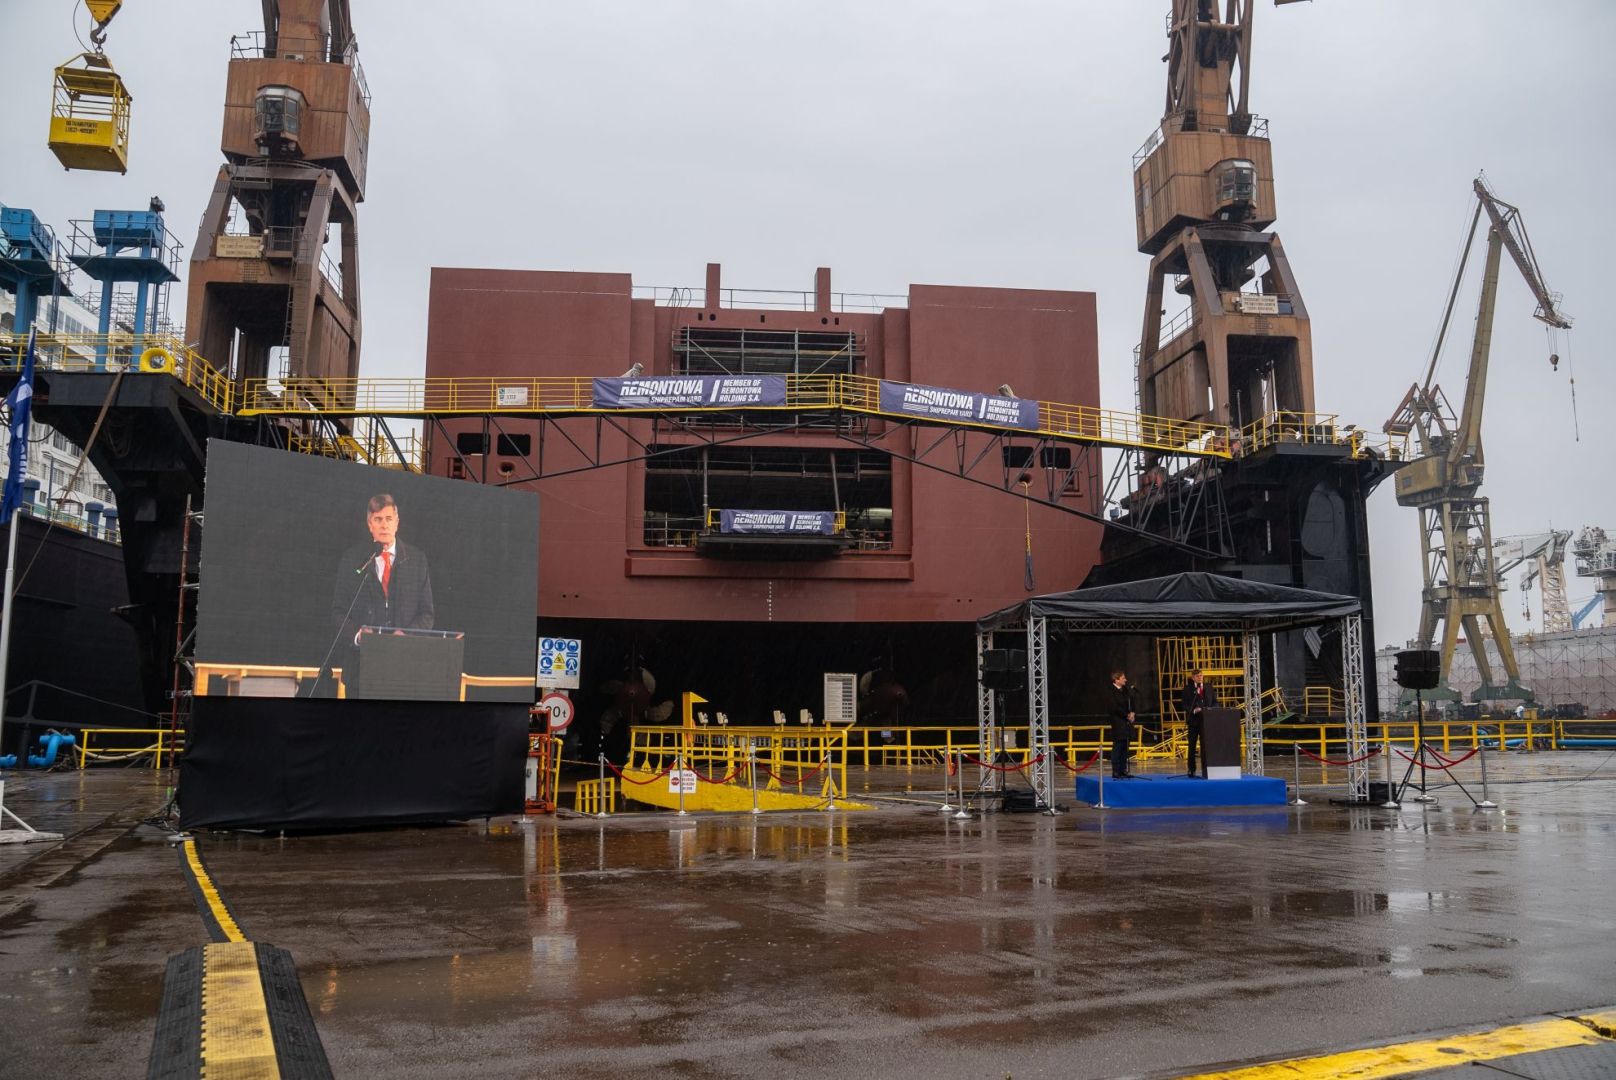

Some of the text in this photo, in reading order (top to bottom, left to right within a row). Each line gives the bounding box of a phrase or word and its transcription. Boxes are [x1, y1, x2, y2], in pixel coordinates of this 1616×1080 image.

[620, 380, 703, 396] REMONTOWA
[904, 388, 973, 409] REMONTOWA
[989, 399, 1019, 409] MEMBER OF
[988, 406, 1020, 416] REMONTOWA
[734, 514, 786, 524] REMONTOWA
